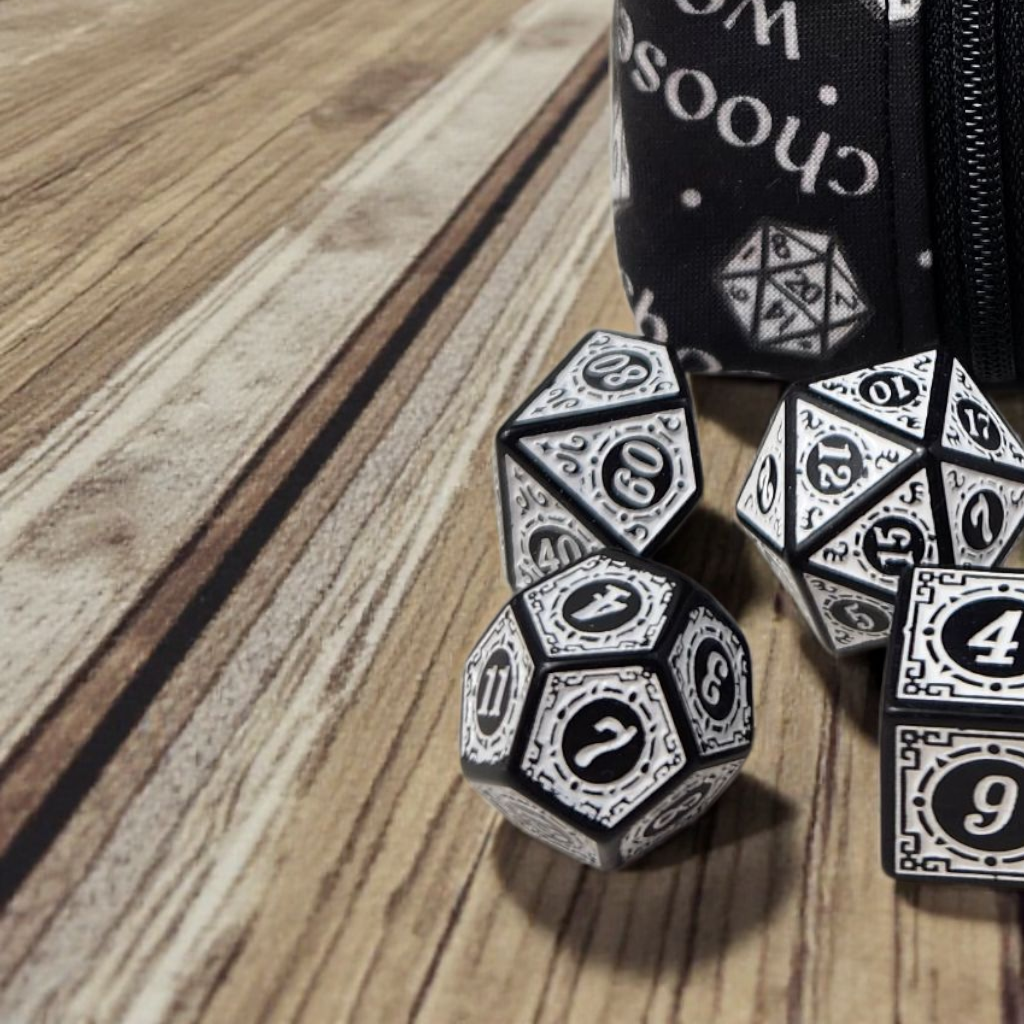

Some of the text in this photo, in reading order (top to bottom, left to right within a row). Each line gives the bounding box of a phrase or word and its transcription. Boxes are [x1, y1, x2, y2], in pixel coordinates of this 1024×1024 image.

[584, 352, 649, 389] 80
[868, 375, 912, 404] 10
[964, 407, 992, 440] 17
[816, 440, 852, 489] 12
[966, 609, 1023, 665] 4
[477, 664, 510, 717] 11
